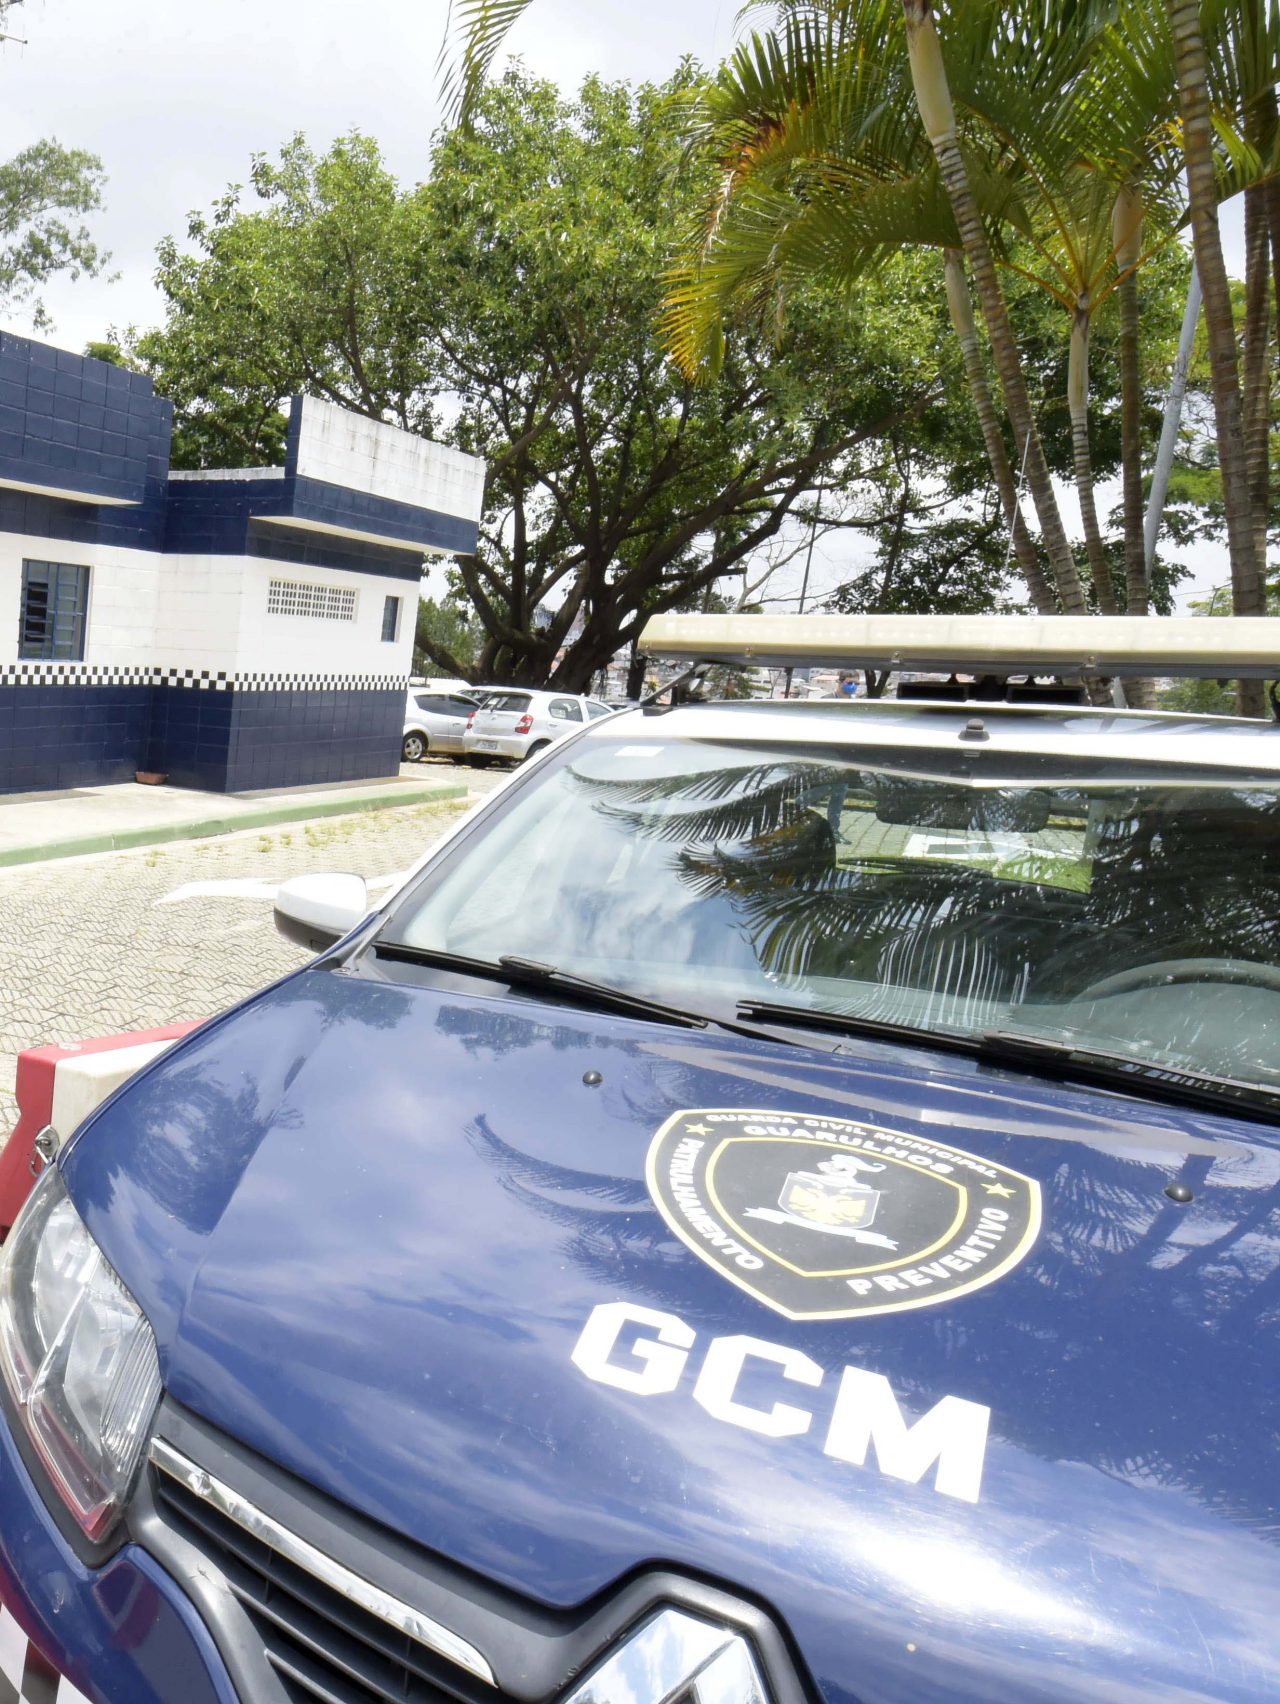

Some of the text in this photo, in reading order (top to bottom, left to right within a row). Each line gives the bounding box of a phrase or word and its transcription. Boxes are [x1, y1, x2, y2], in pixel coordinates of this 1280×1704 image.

[705, 1114, 997, 1179] GUARDA CIVIL MUNICIPAL
[743, 1125, 954, 1175] GUARULHOS
[846, 1207, 1009, 1295] PREVENTIVO
[571, 1301, 991, 1504] GCM
